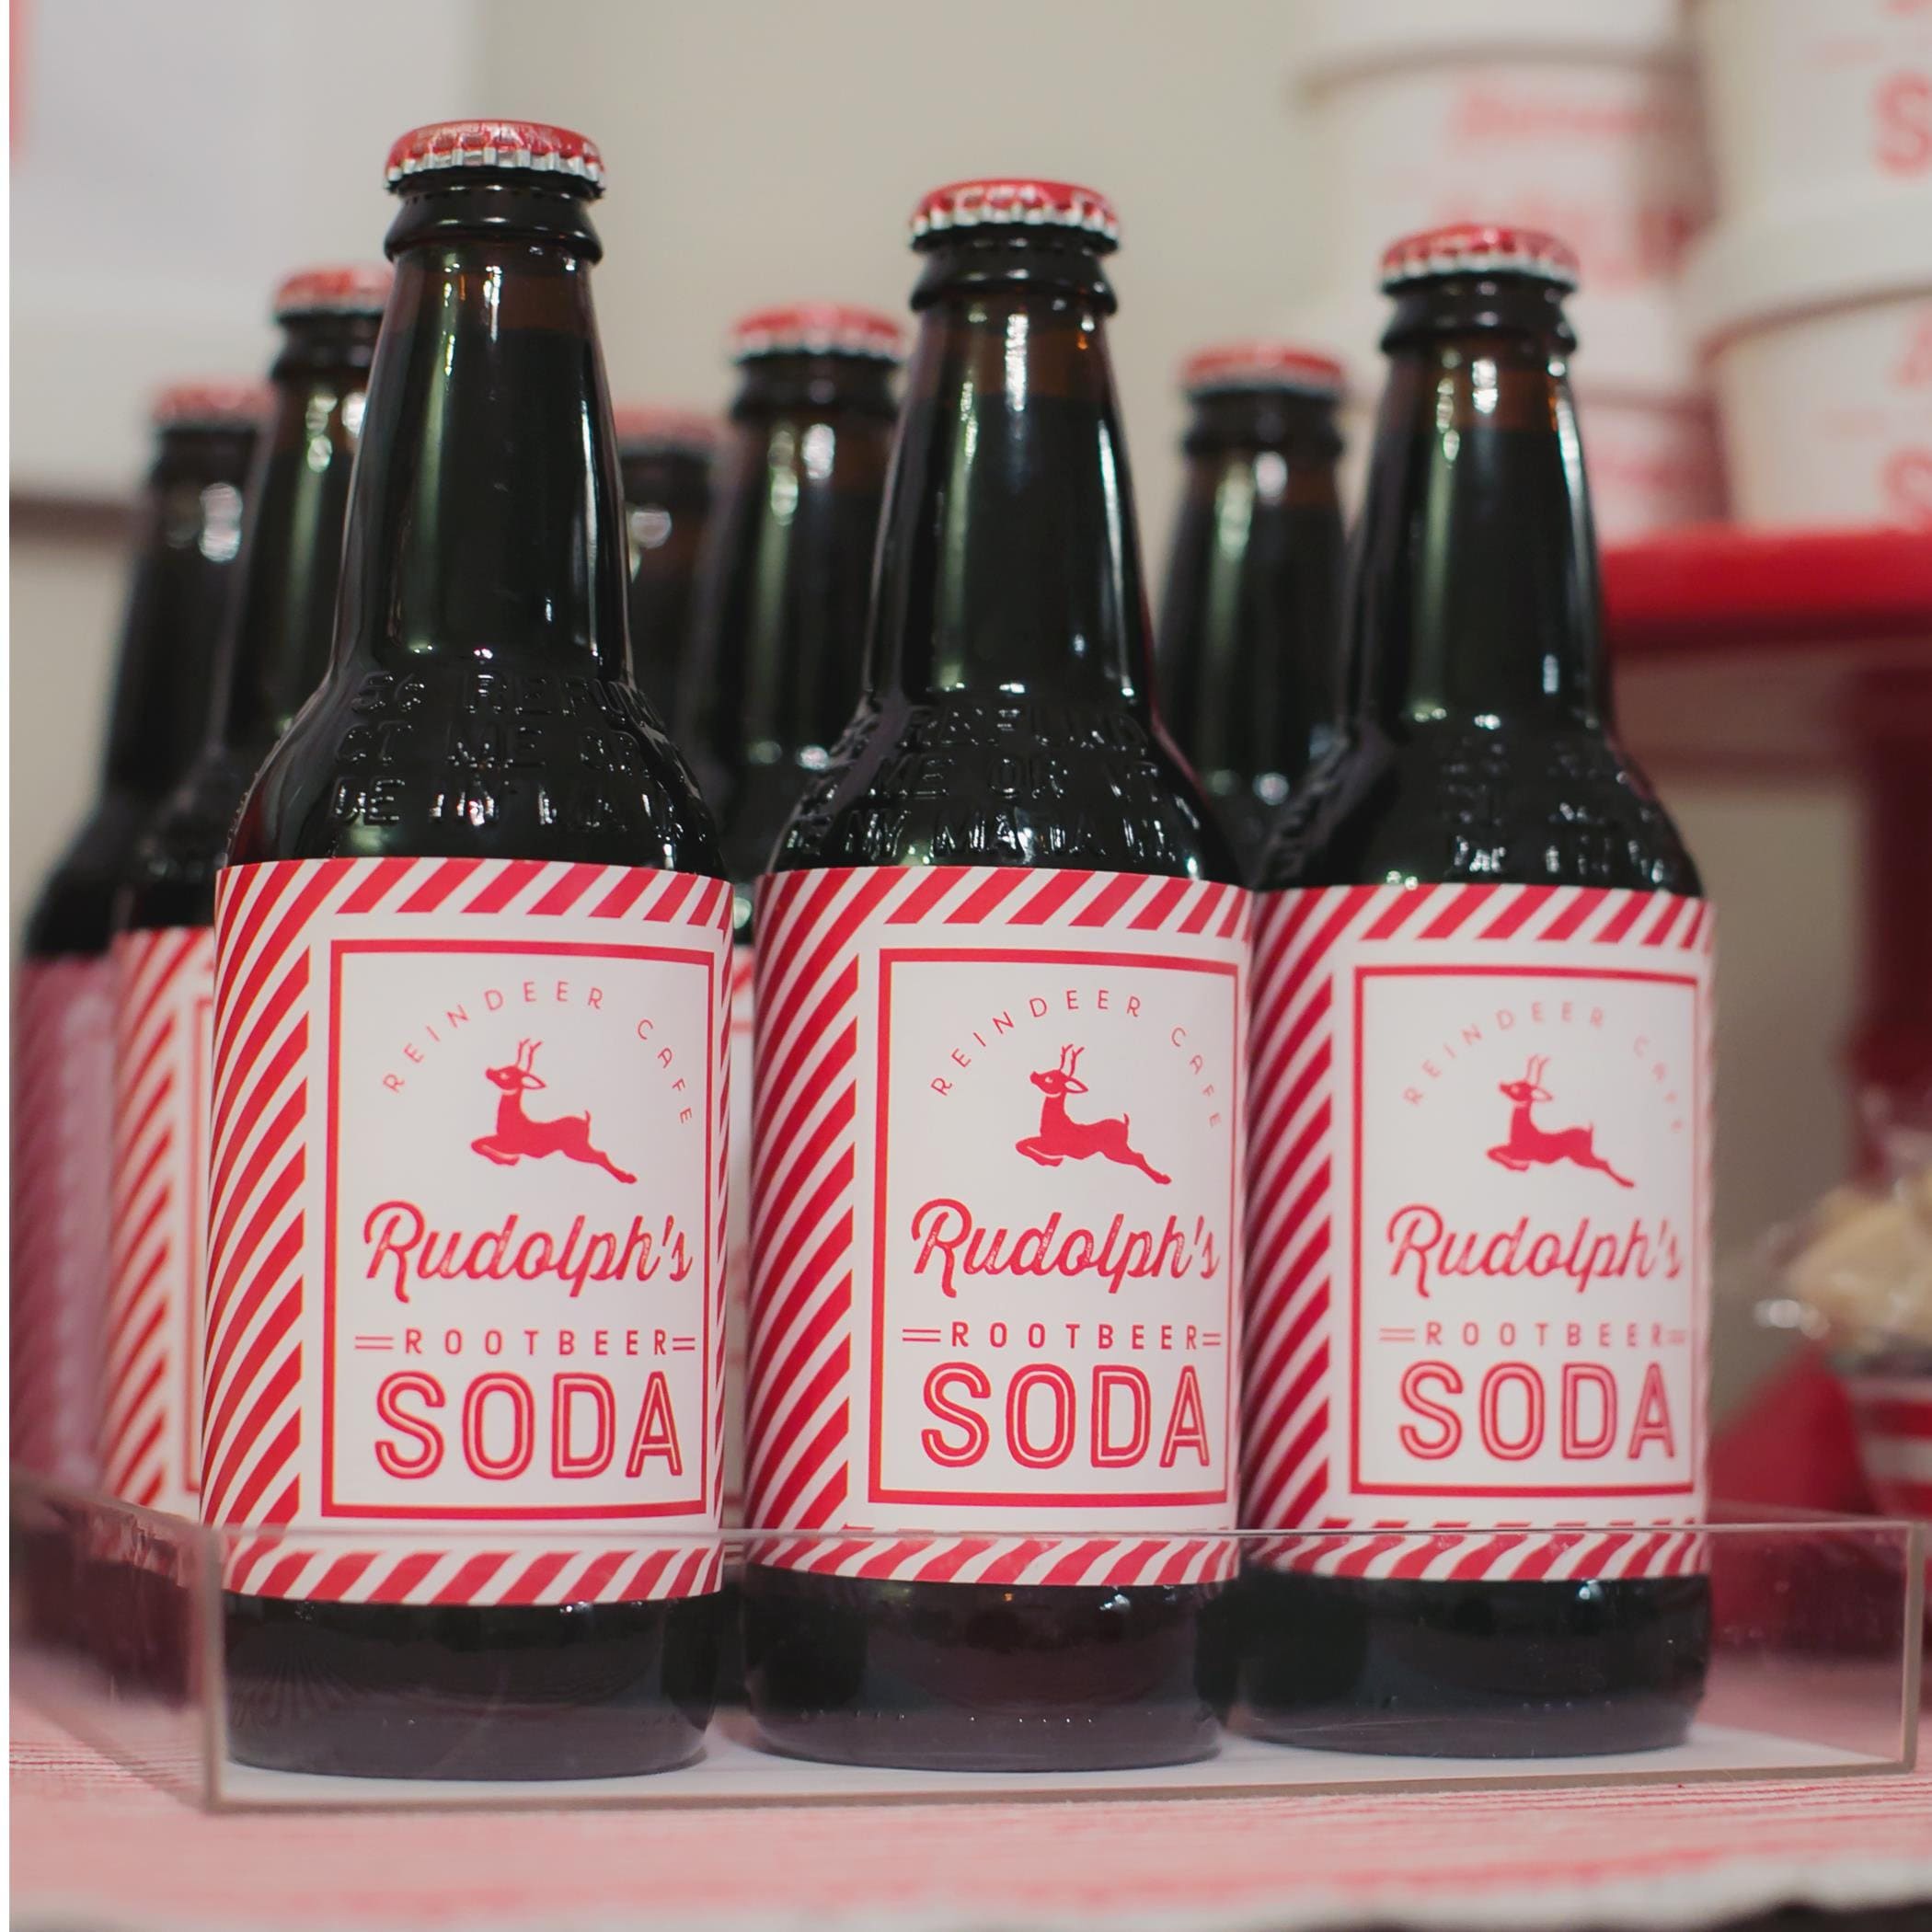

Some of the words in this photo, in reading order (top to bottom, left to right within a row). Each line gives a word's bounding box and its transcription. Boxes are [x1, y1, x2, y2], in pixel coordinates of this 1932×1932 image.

[383, 981, 604, 1093] REINDEER
[636, 1018, 694, 1124] CAFE
[930, 989, 1141, 1096] REINDEER
[1169, 1026, 1222, 1127] CAFE
[1402, 1001, 1605, 1106] REINDEER
[362, 1200, 693, 1304] Rudolph's
[911, 1198, 1220, 1298] Rudolph's
[1386, 1203, 1682, 1298] Rudolph's
[404, 1328, 667, 1357] ROOTBEER
[951, 1321, 1197, 1351] ROOTBEER
[374, 1371, 684, 1481] SODA
[921, 1362, 1210, 1469] SODA
[1398, 1361, 1674, 1461] SODA
